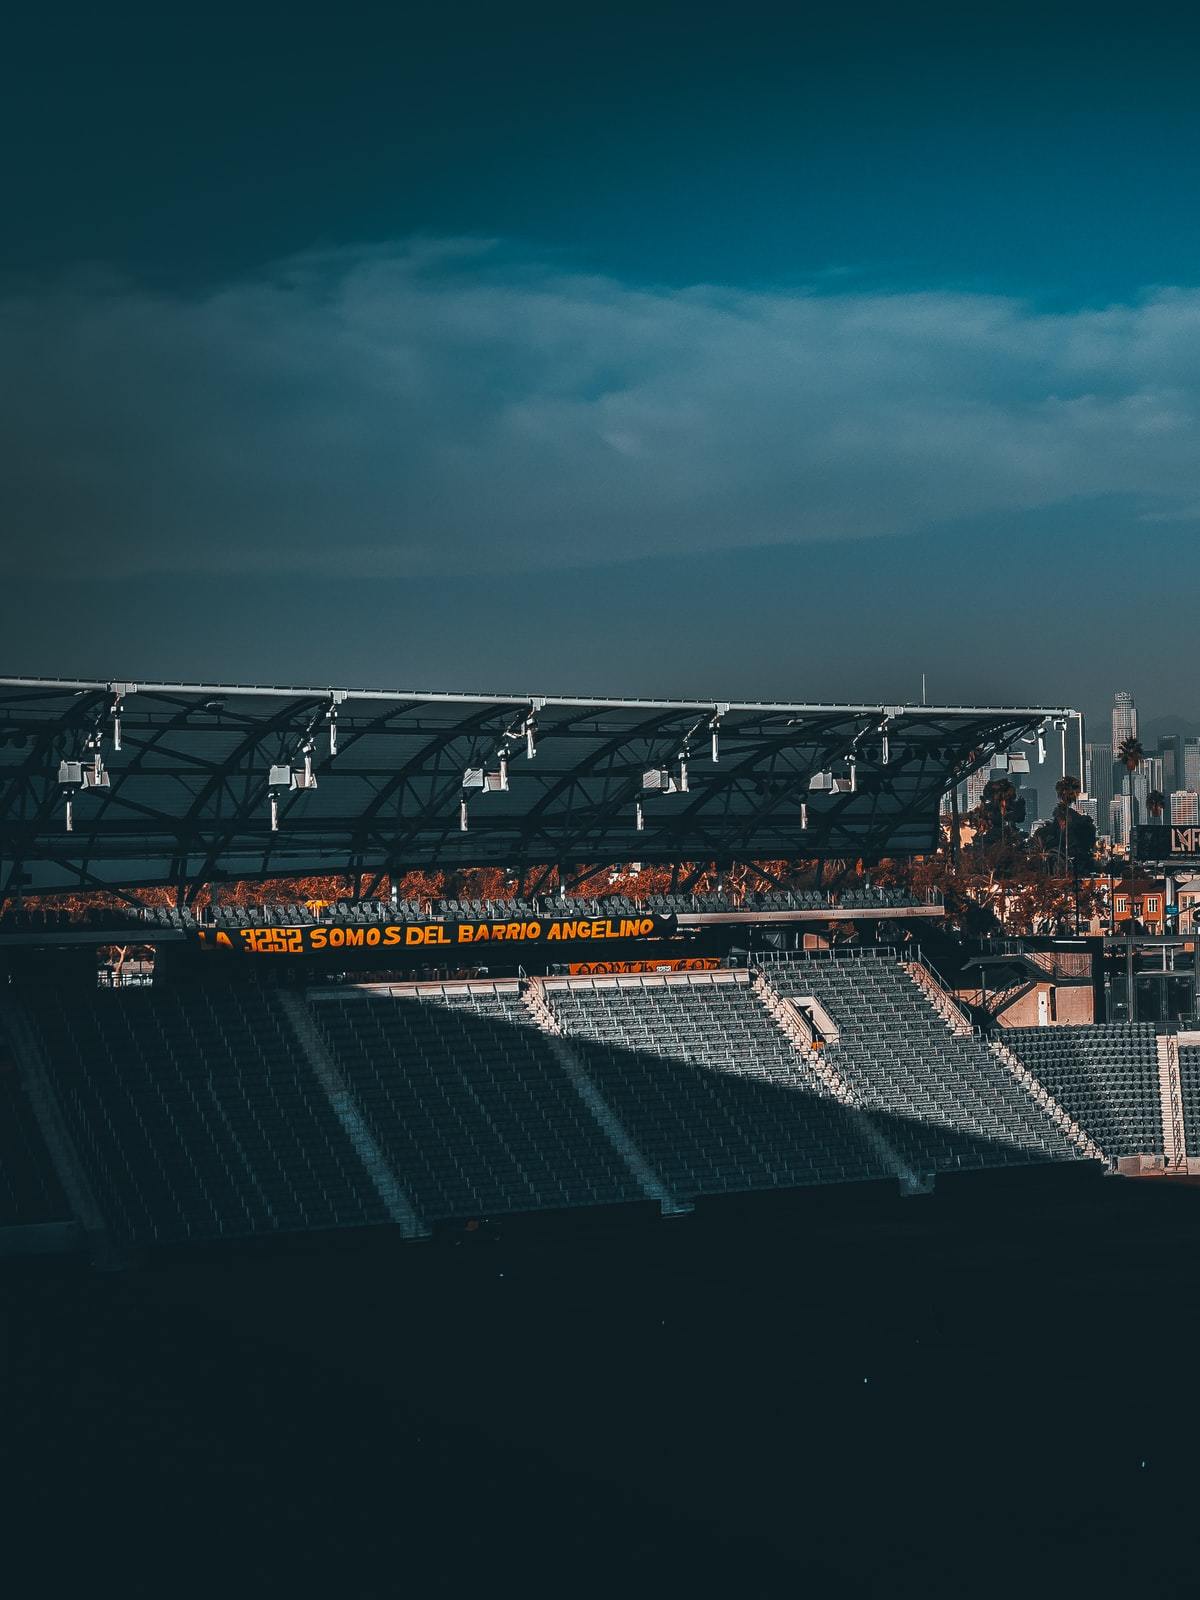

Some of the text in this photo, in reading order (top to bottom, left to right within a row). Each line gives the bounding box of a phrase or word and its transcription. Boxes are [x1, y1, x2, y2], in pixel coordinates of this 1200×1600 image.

[198, 918, 654, 953] LA 3252 SOMOS DEL BARRIO ANGELINO
